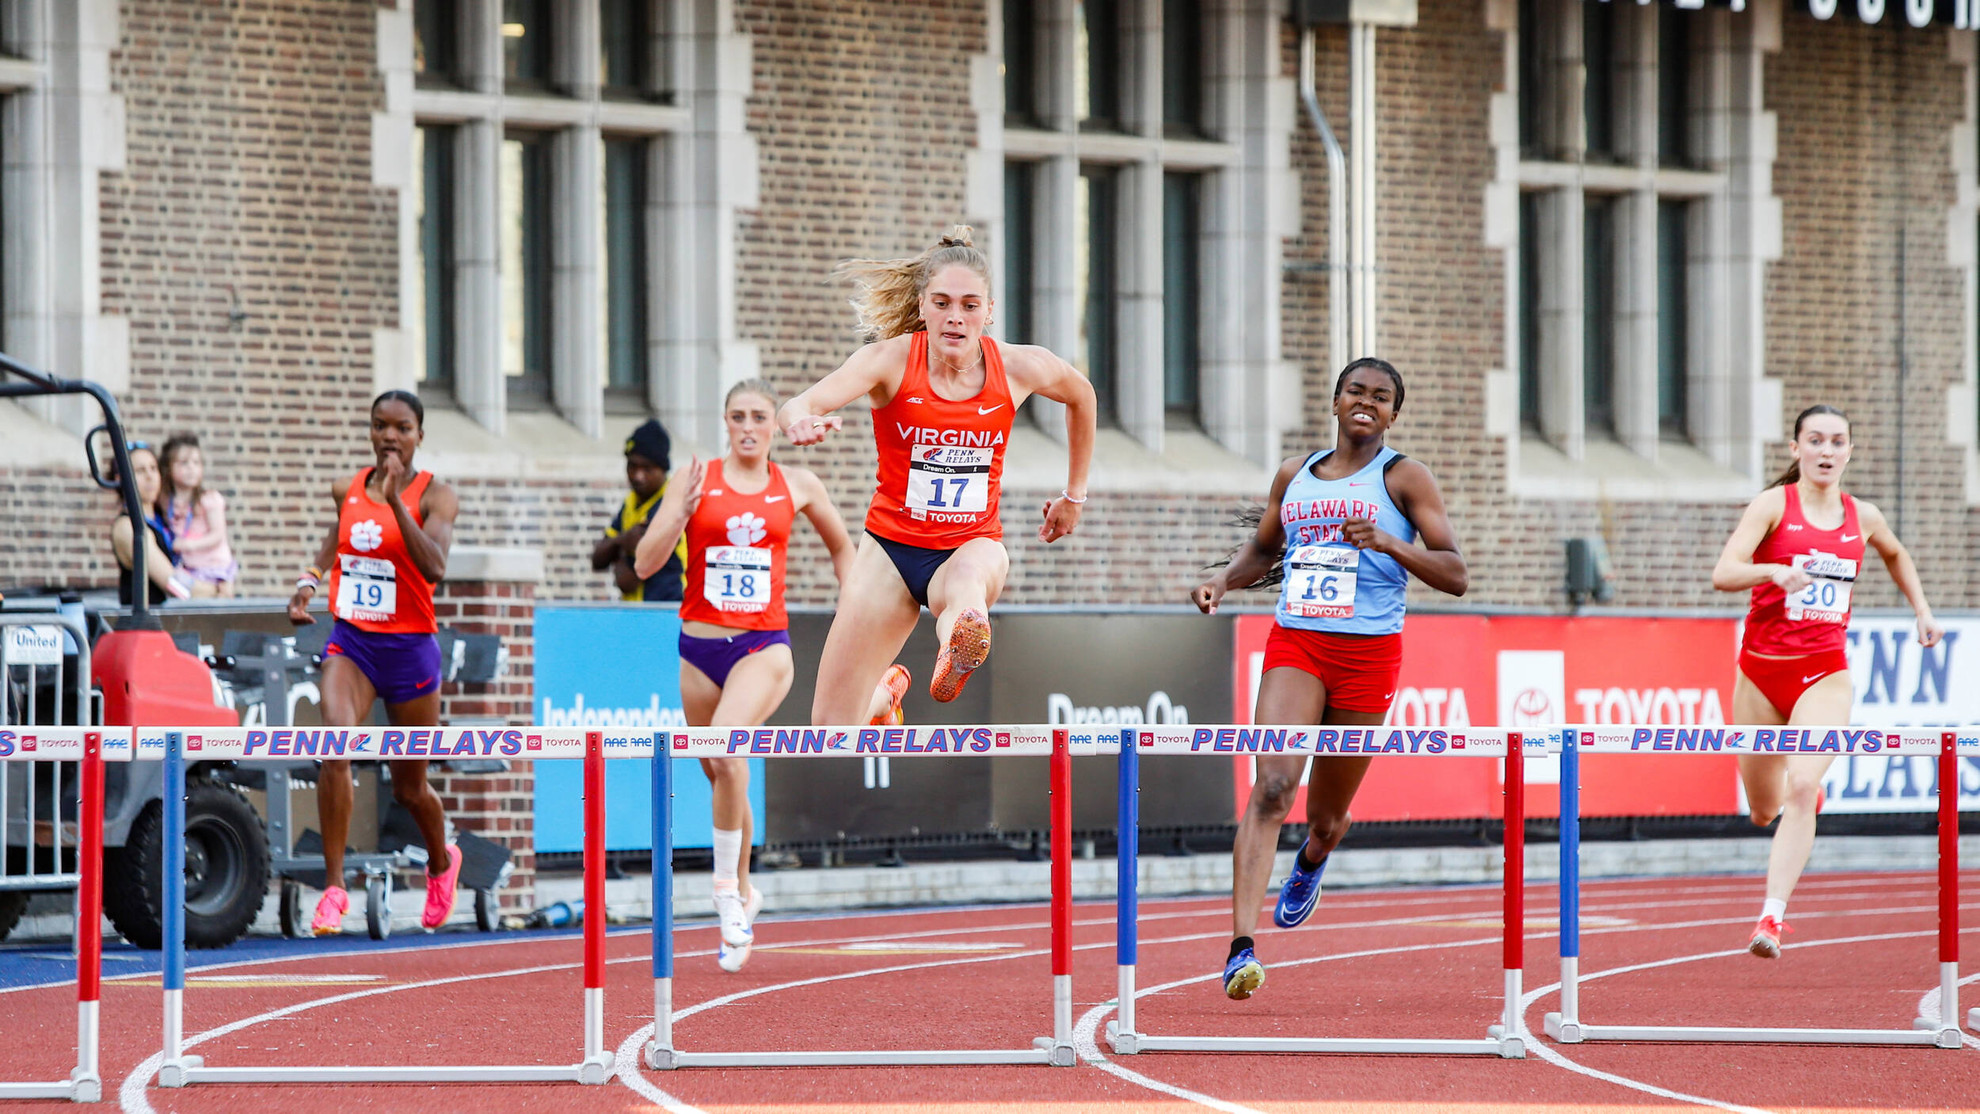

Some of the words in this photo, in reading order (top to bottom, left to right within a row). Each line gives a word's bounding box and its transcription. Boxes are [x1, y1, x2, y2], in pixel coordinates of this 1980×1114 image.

[896, 422, 1004, 447] VIRGINIA
[945, 456, 982, 464] RELAYS
[923, 464, 944, 473] Dream
[927, 478, 970, 507] 17
[929, 512, 977, 524] TOYOTA
[721, 574, 755, 598] 18
[1302, 575, 1339, 601] 16
[352, 583, 383, 607] 19
[1802, 582, 1836, 607] 30
[724, 602, 764, 612] TOYOTA
[1304, 606, 1347, 616] TOYOTA
[1804, 611, 1843, 621] TOYOTA
[16, 633, 57, 648] United
[1575, 686, 1725, 725] TOYOTA
[40, 739, 79, 748] TOYOTA
[206, 739, 242, 747] TOYOTA
[243, 731, 349, 755] PENN
[379, 731, 522, 756] RELAYS
[691, 738, 725, 746] TOYOTA
[727, 730, 827, 753] PENN
[856, 729, 992, 753] RELAYS
[1191, 729, 1288, 751] PENN
[1315, 729, 1448, 753] RELAYS
[1469, 738, 1502, 746] TOYOTA
[1597, 735, 1630, 743] TOYOTA
[1631, 729, 1725, 751] PENN
[1753, 729, 1883, 753] RELAYS
